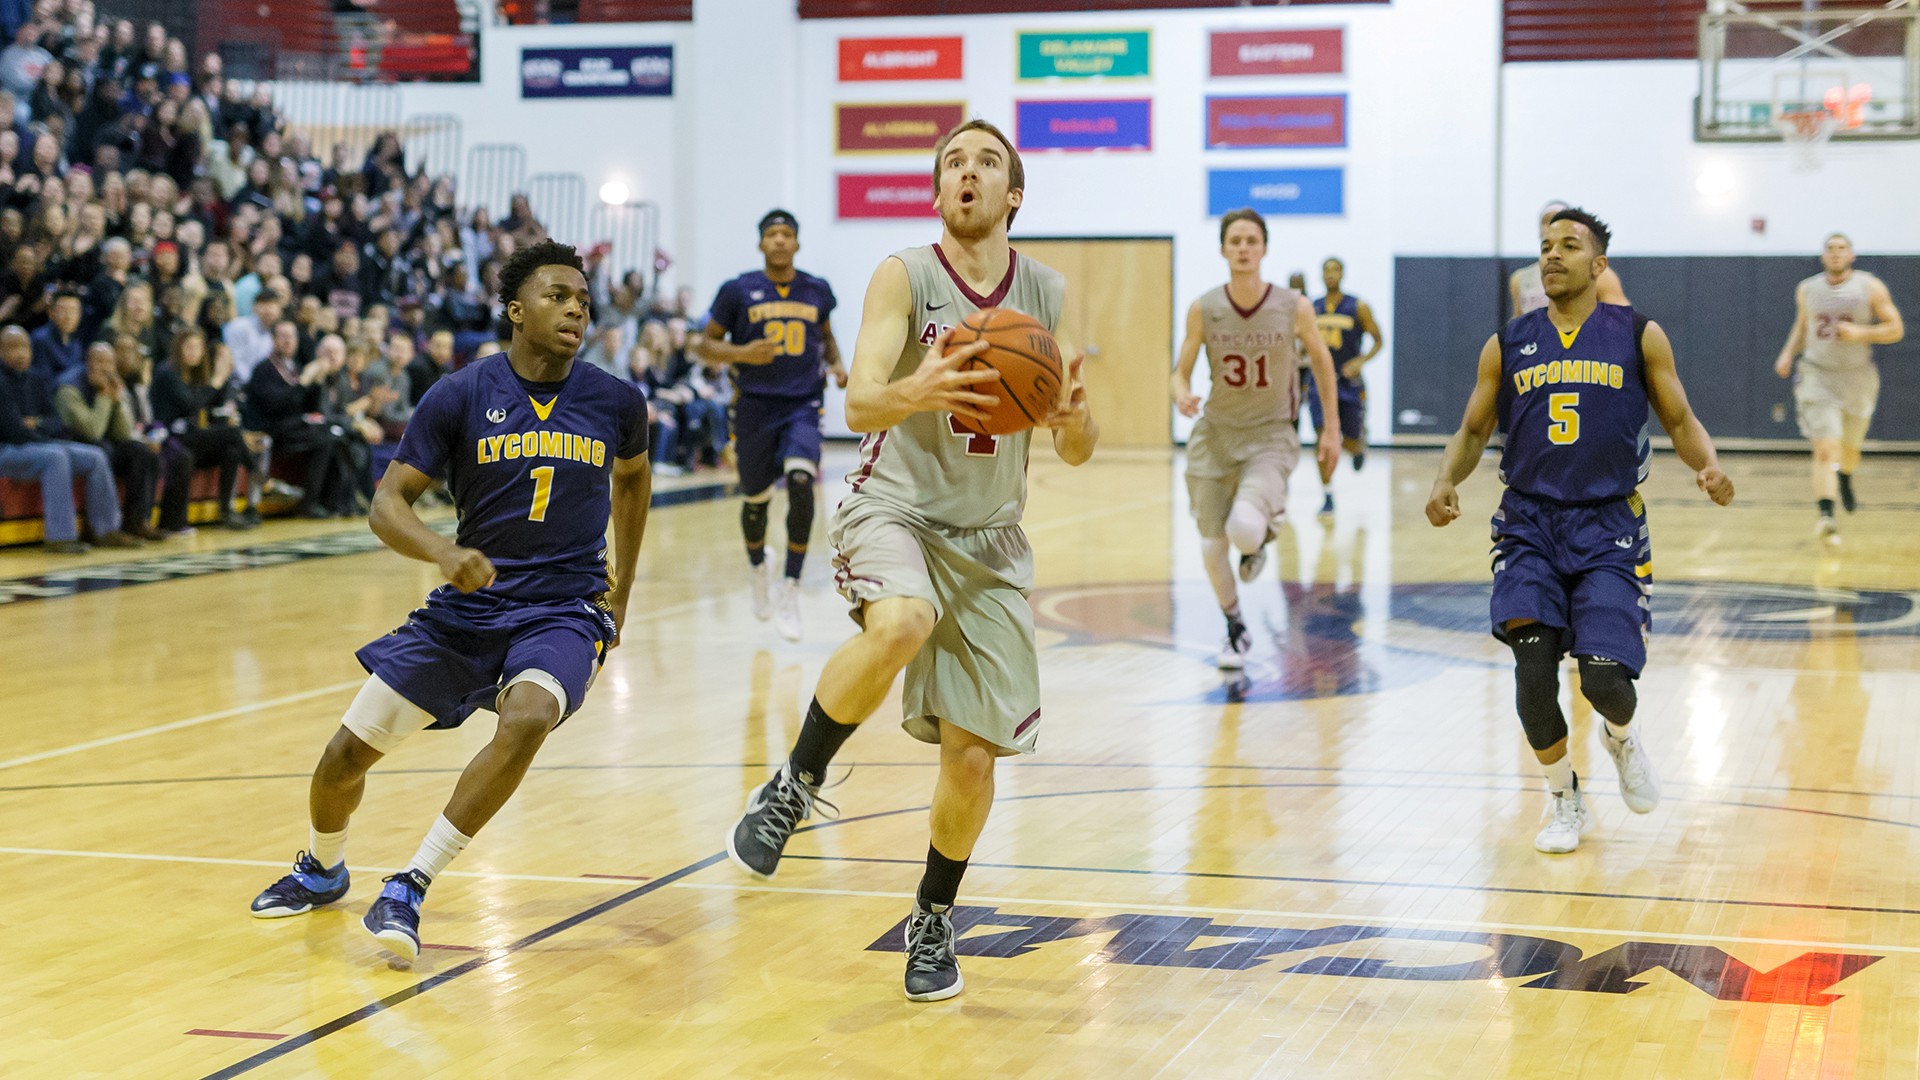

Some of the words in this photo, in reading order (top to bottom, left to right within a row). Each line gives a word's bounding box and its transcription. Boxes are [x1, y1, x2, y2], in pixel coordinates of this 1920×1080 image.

[1211, 332, 1286, 347] ARCADIA
[1221, 352, 1271, 391] 31
[1513, 359, 1624, 396] LYCOMING
[1548, 392, 1580, 445] 5
[477, 430, 606, 468] LYCOMING
[528, 465, 555, 523] 1
